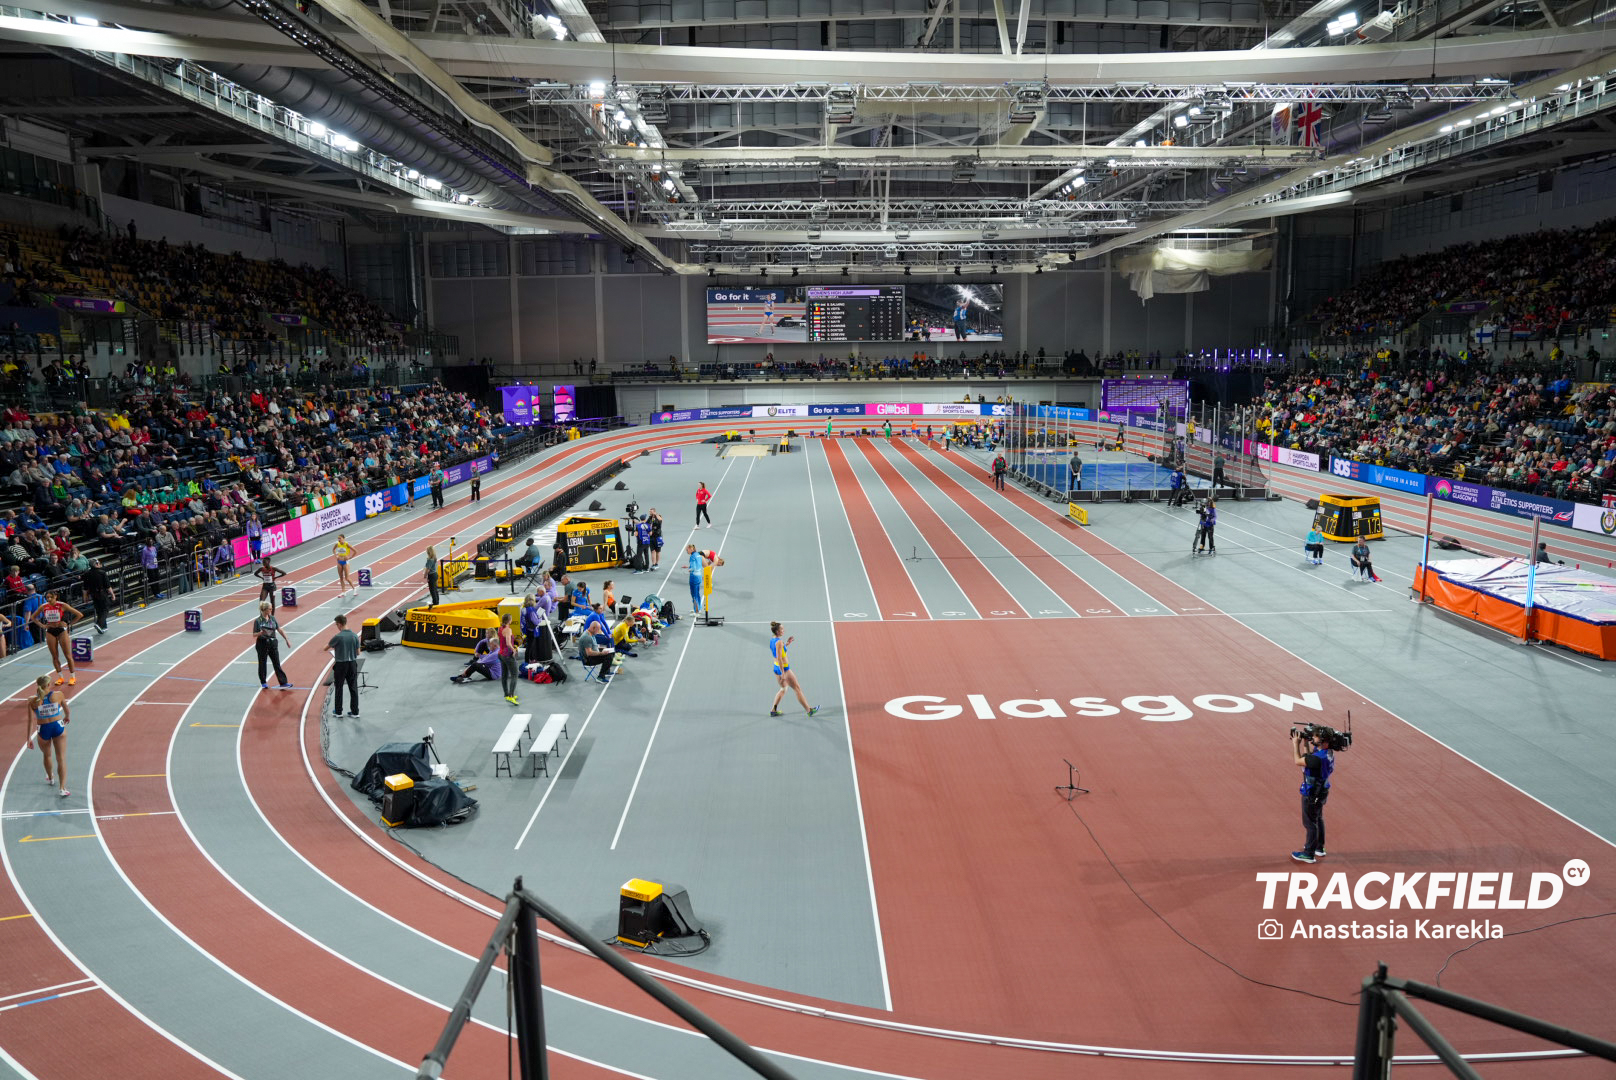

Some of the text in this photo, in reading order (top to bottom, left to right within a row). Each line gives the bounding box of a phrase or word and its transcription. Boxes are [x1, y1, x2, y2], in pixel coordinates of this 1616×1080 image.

[877, 404, 910, 414] Global
[1334, 458, 1351, 477] SOS
[366, 492, 383, 515] SOS
[1491, 496, 1554, 515] ATHLETICS SUPPORTERS
[320, 508, 341, 521] HAMPDEN
[321, 514, 351, 531] SPORTS CLINIC
[567, 537, 584, 547] LOBAN
[594, 544, 618, 562] 1.73
[361, 573, 368, 581] 2
[285, 591, 293, 600] 3
[188, 615, 196, 625] 4
[411, 613, 437, 622] SEIKO
[414, 622, 478, 638] 11:34:50
[76, 642, 86, 655] 5
[885, 692, 1323, 721] Glasgow
